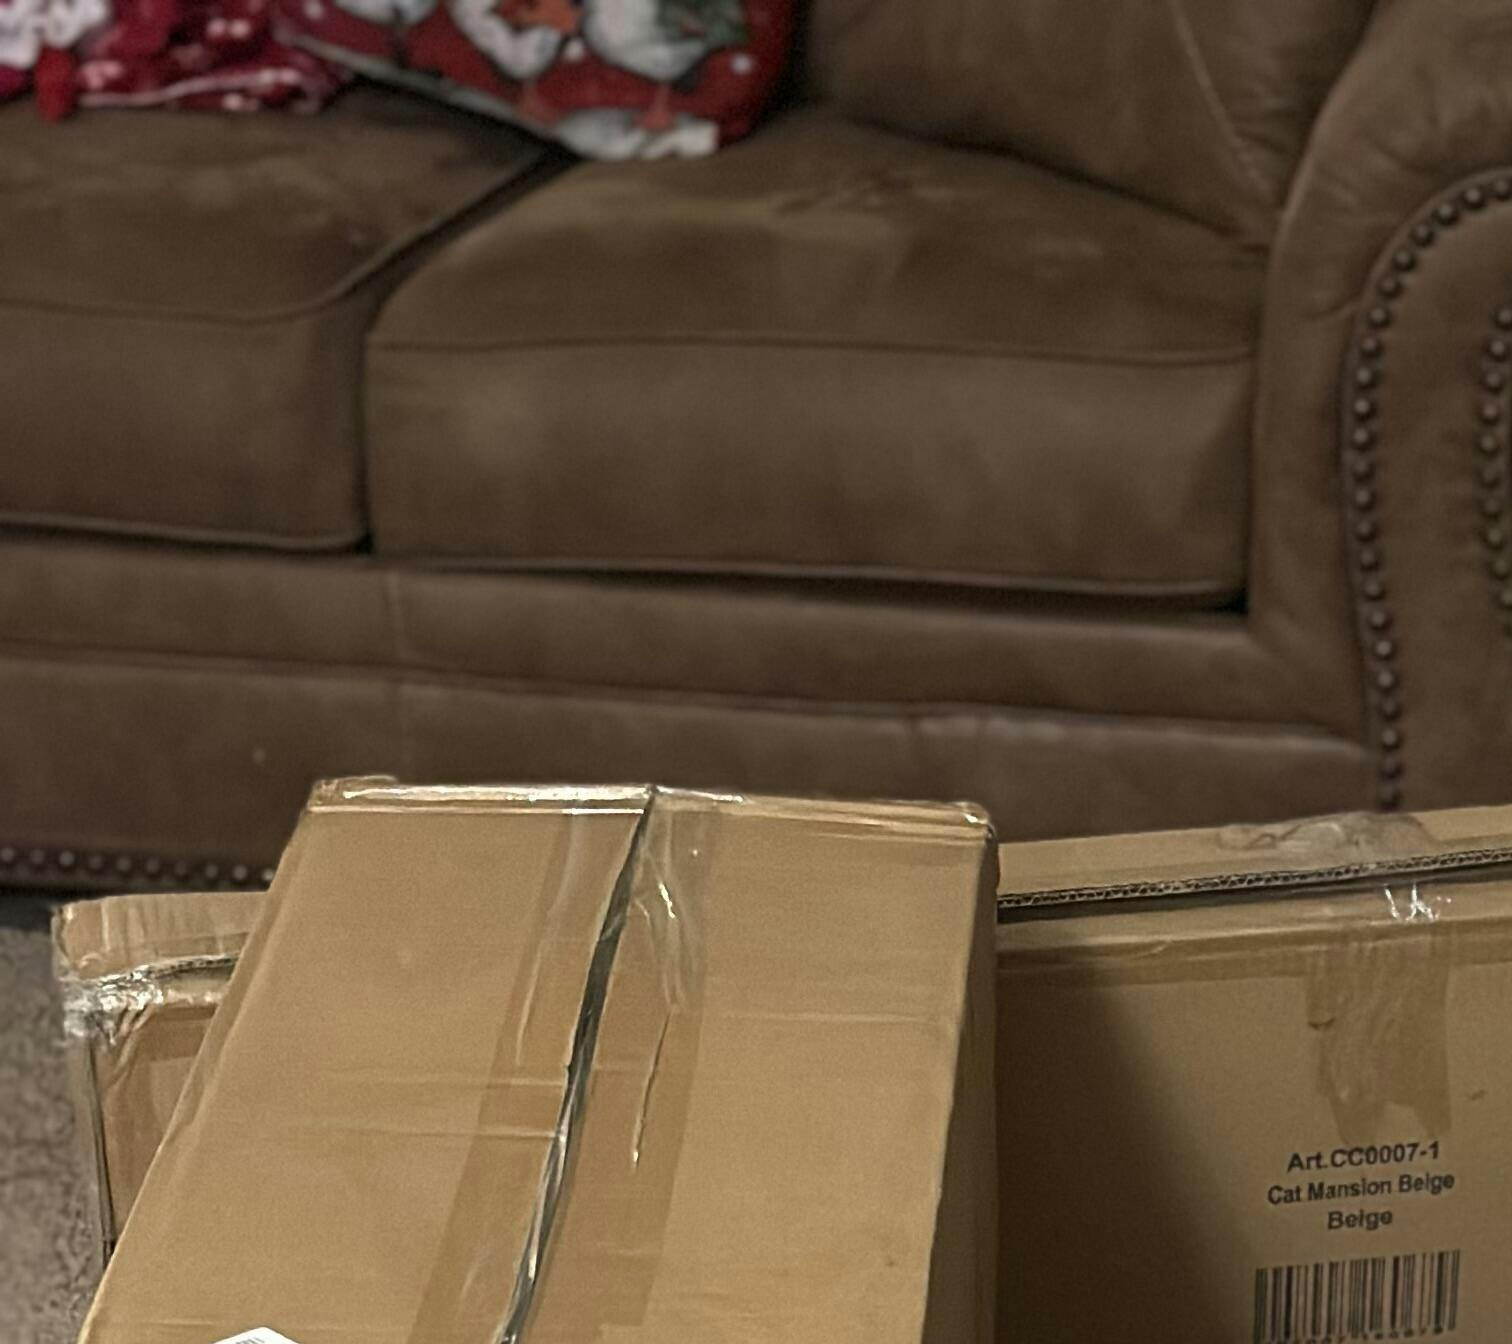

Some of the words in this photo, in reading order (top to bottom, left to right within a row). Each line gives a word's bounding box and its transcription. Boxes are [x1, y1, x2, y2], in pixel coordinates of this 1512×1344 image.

[1286, 1140, 1439, 1173] Art.CC0007-1
[1267, 1184, 1302, 1206] Cat
[1307, 1177, 1392, 1202] Mansion
[1398, 1172, 1455, 1196] Beige
[1327, 1208, 1394, 1232] Beige
